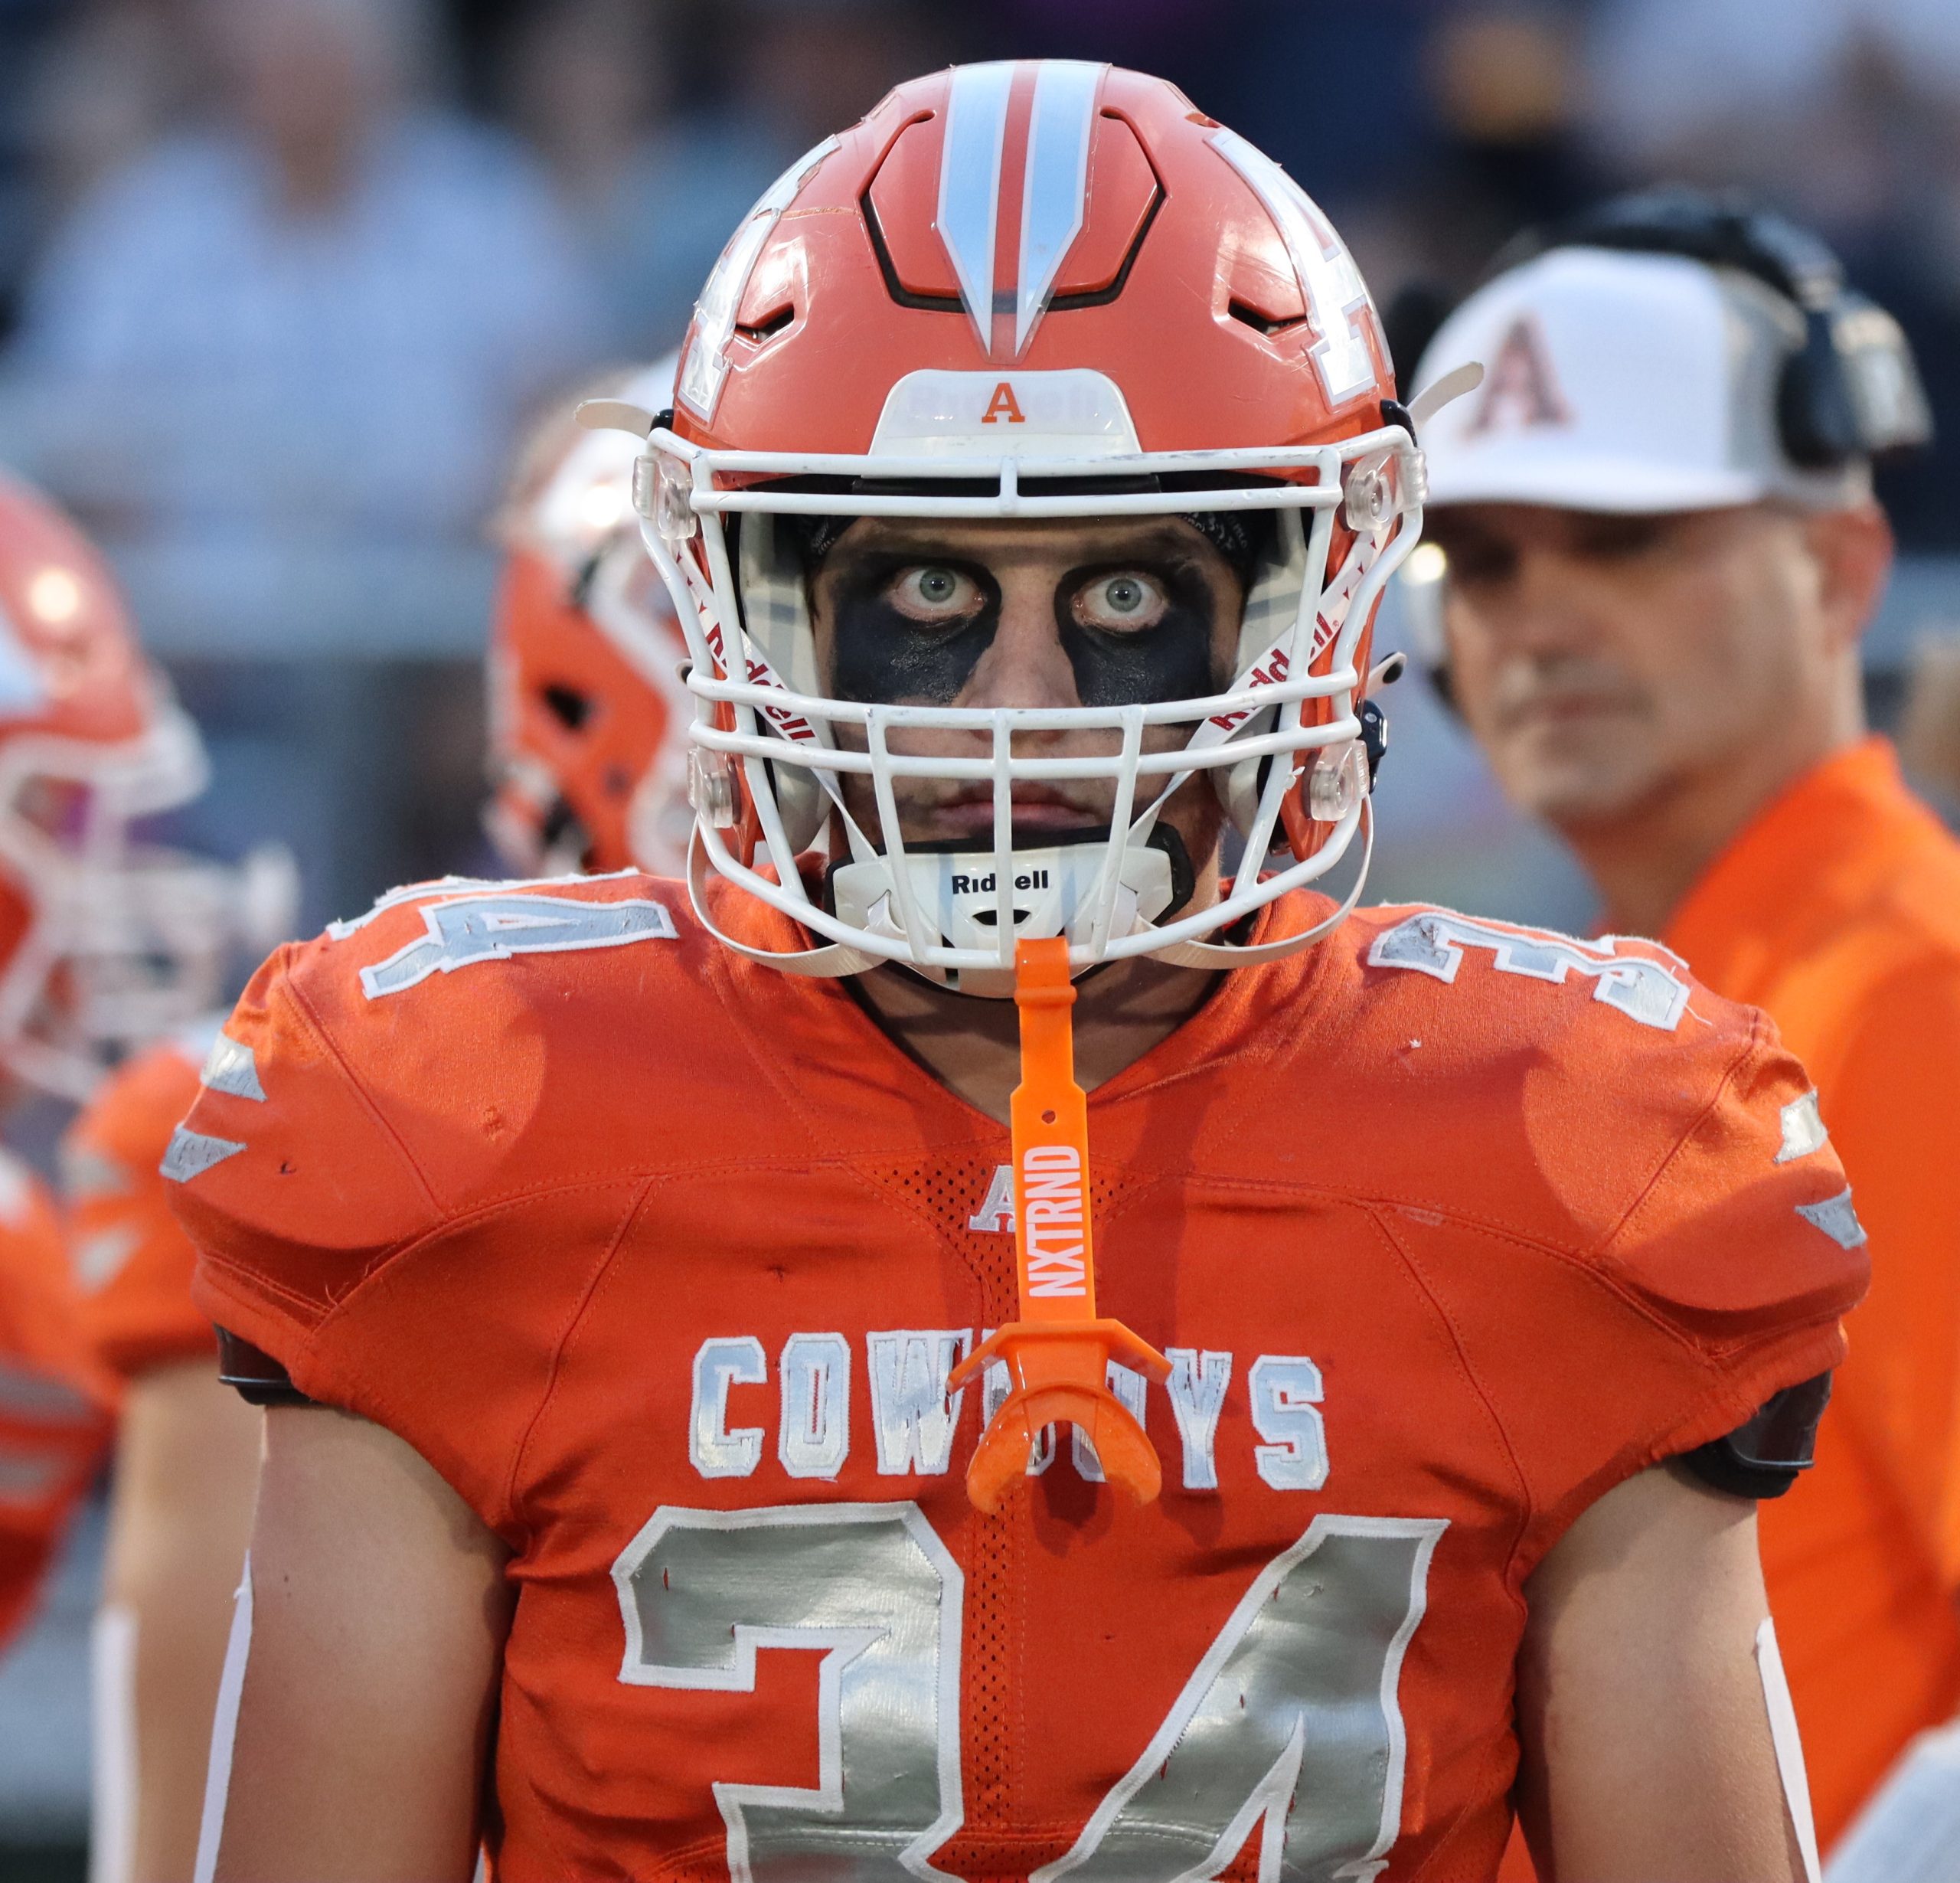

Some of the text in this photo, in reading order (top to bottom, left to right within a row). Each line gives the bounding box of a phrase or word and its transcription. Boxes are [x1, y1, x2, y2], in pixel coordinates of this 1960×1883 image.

[982, 382, 1025, 423] A
[1466, 315, 1579, 440] A
[952, 870, 1048, 894] Ridell
[1024, 1146, 1086, 1297] NXTRND
[689, 1328, 1330, 1491] COWYS
